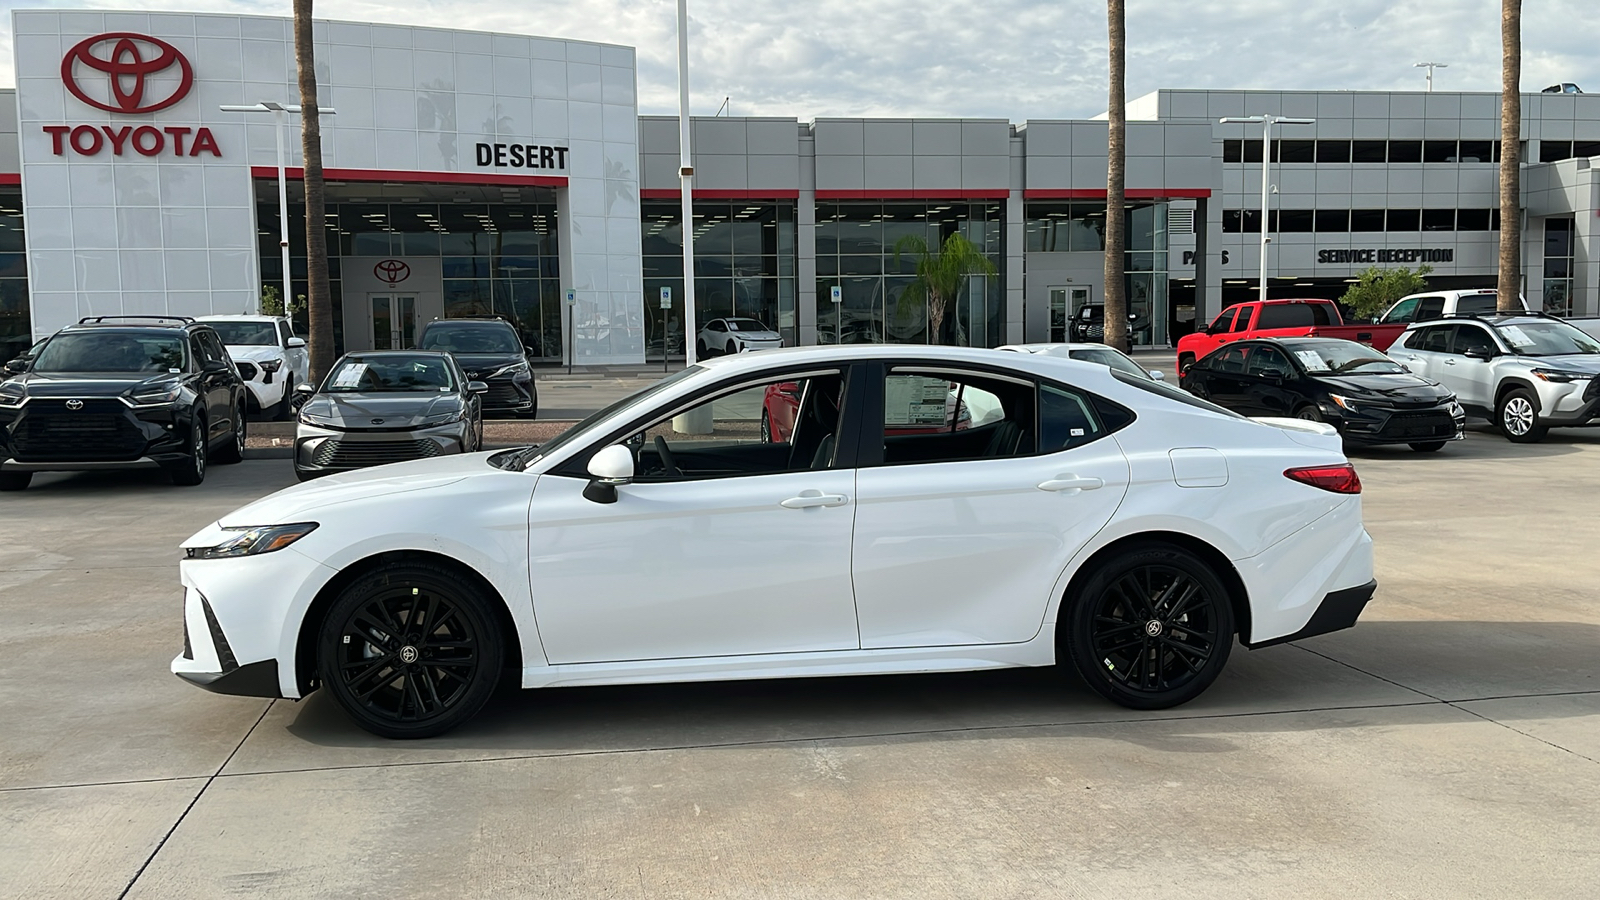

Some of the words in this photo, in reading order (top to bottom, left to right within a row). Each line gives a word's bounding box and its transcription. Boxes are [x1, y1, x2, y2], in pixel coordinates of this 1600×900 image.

[43, 125, 222, 157] TOYOTA
[476, 143, 569, 169] DESERT
[1318, 249, 1376, 263] SERVICE
[1377, 248, 1454, 263] RECEPTION
